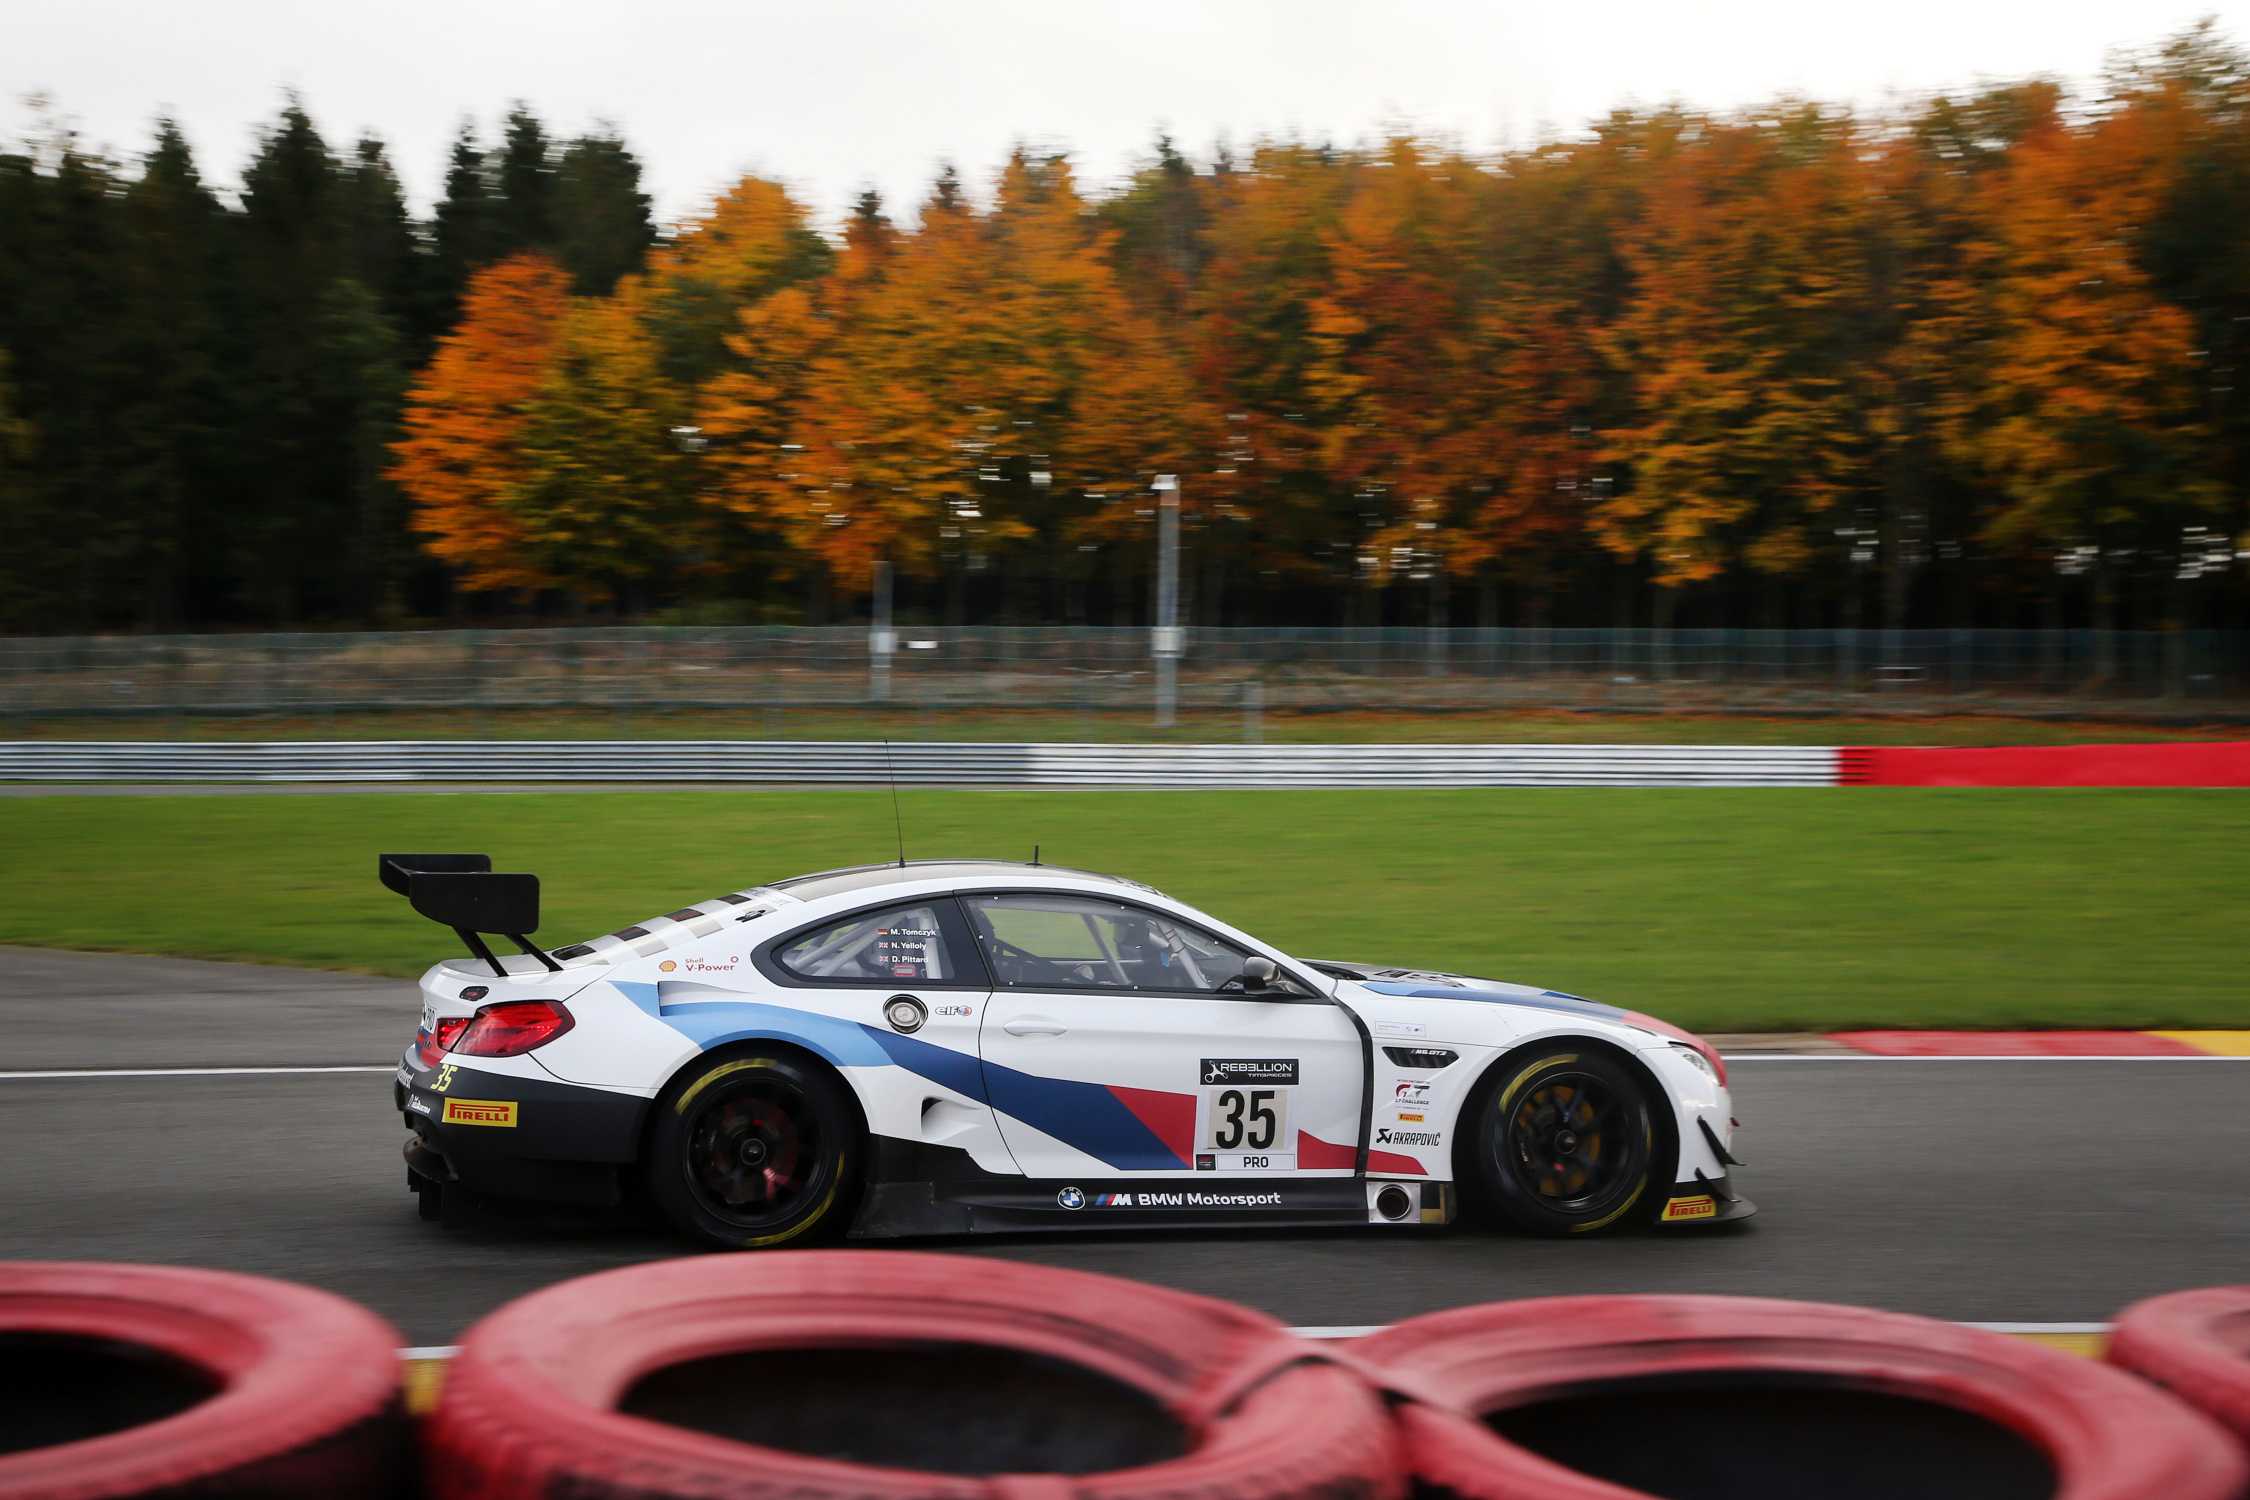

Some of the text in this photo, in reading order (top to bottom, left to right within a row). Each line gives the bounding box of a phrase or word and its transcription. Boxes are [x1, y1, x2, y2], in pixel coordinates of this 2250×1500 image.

[902, 928, 937, 936] Tomczyk
[901, 942, 927, 950] Yelloly
[891, 955, 929, 963] D. Pittard
[686, 964, 735, 972] V-Power
[1220, 1063, 1293, 1072] REBELLION
[430, 1063, 459, 1092] 35
[448, 1103, 511, 1122] PIRELLI
[1215, 1089, 1277, 1150] 35
[1242, 1156, 1270, 1168] PRO
[1137, 1193, 1183, 1206] BMW
[1187, 1192, 1283, 1207] Motorsport
[1669, 1199, 1713, 1216] PIRELLI
